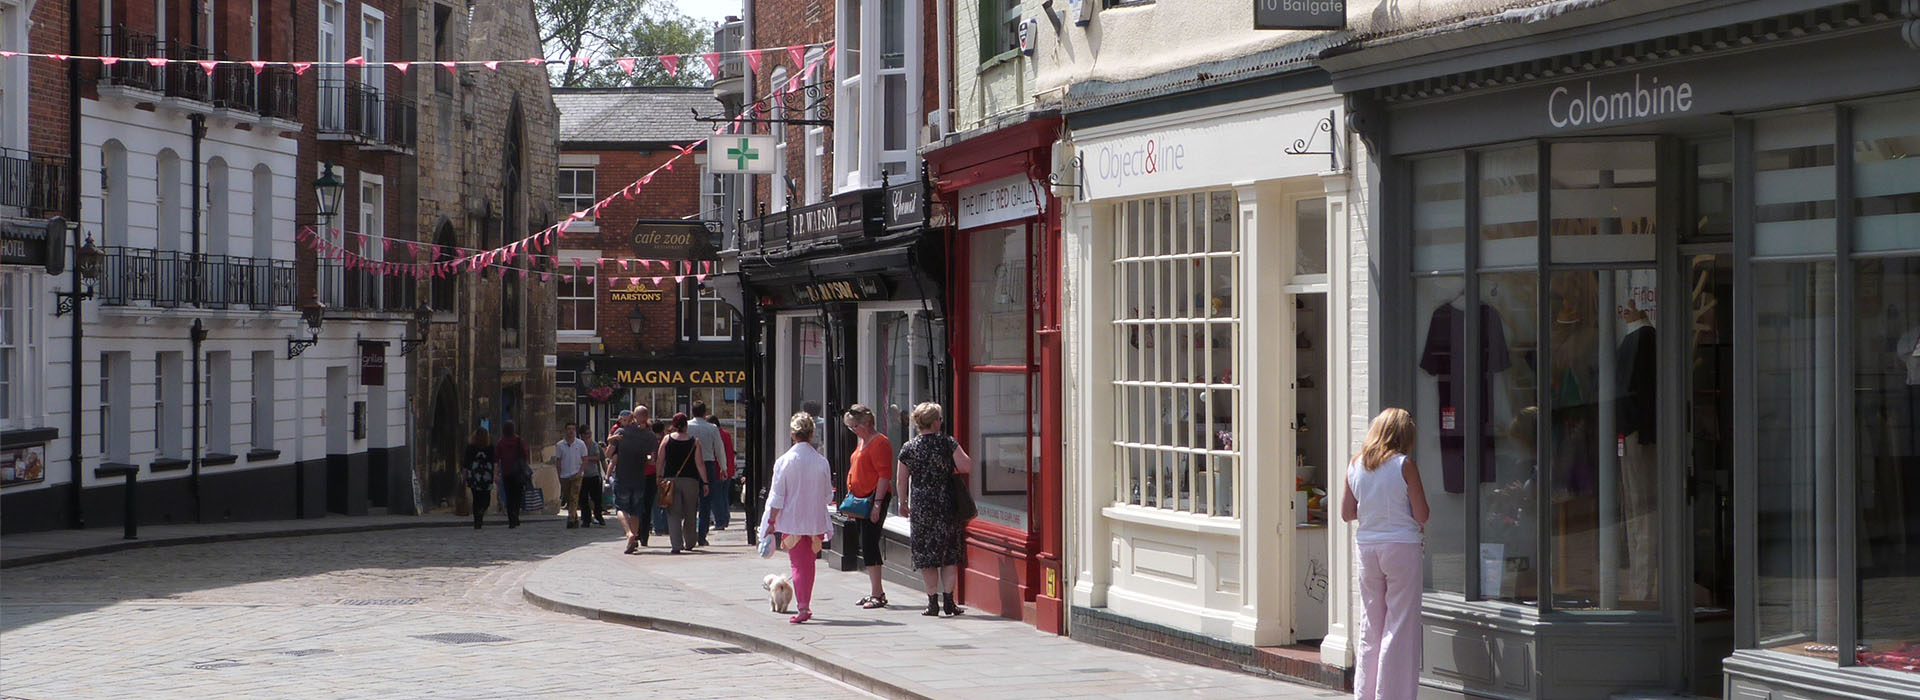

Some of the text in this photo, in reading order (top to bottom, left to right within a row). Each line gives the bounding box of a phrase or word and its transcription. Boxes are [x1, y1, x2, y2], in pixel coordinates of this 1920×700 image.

[1260, 0, 1343, 15] 10 Bailgate
[1548, 73, 1693, 128] Colombine
[962, 183, 1035, 216] THE LITTLE RED GALLE
[806, 206, 838, 233] WATSON
[634, 231, 691, 245] cafe zoot
[1, 239, 26, 257] HOTEL
[611, 293, 661, 301] MARSTON'S
[617, 370, 746, 384] MAGNA CARTA
